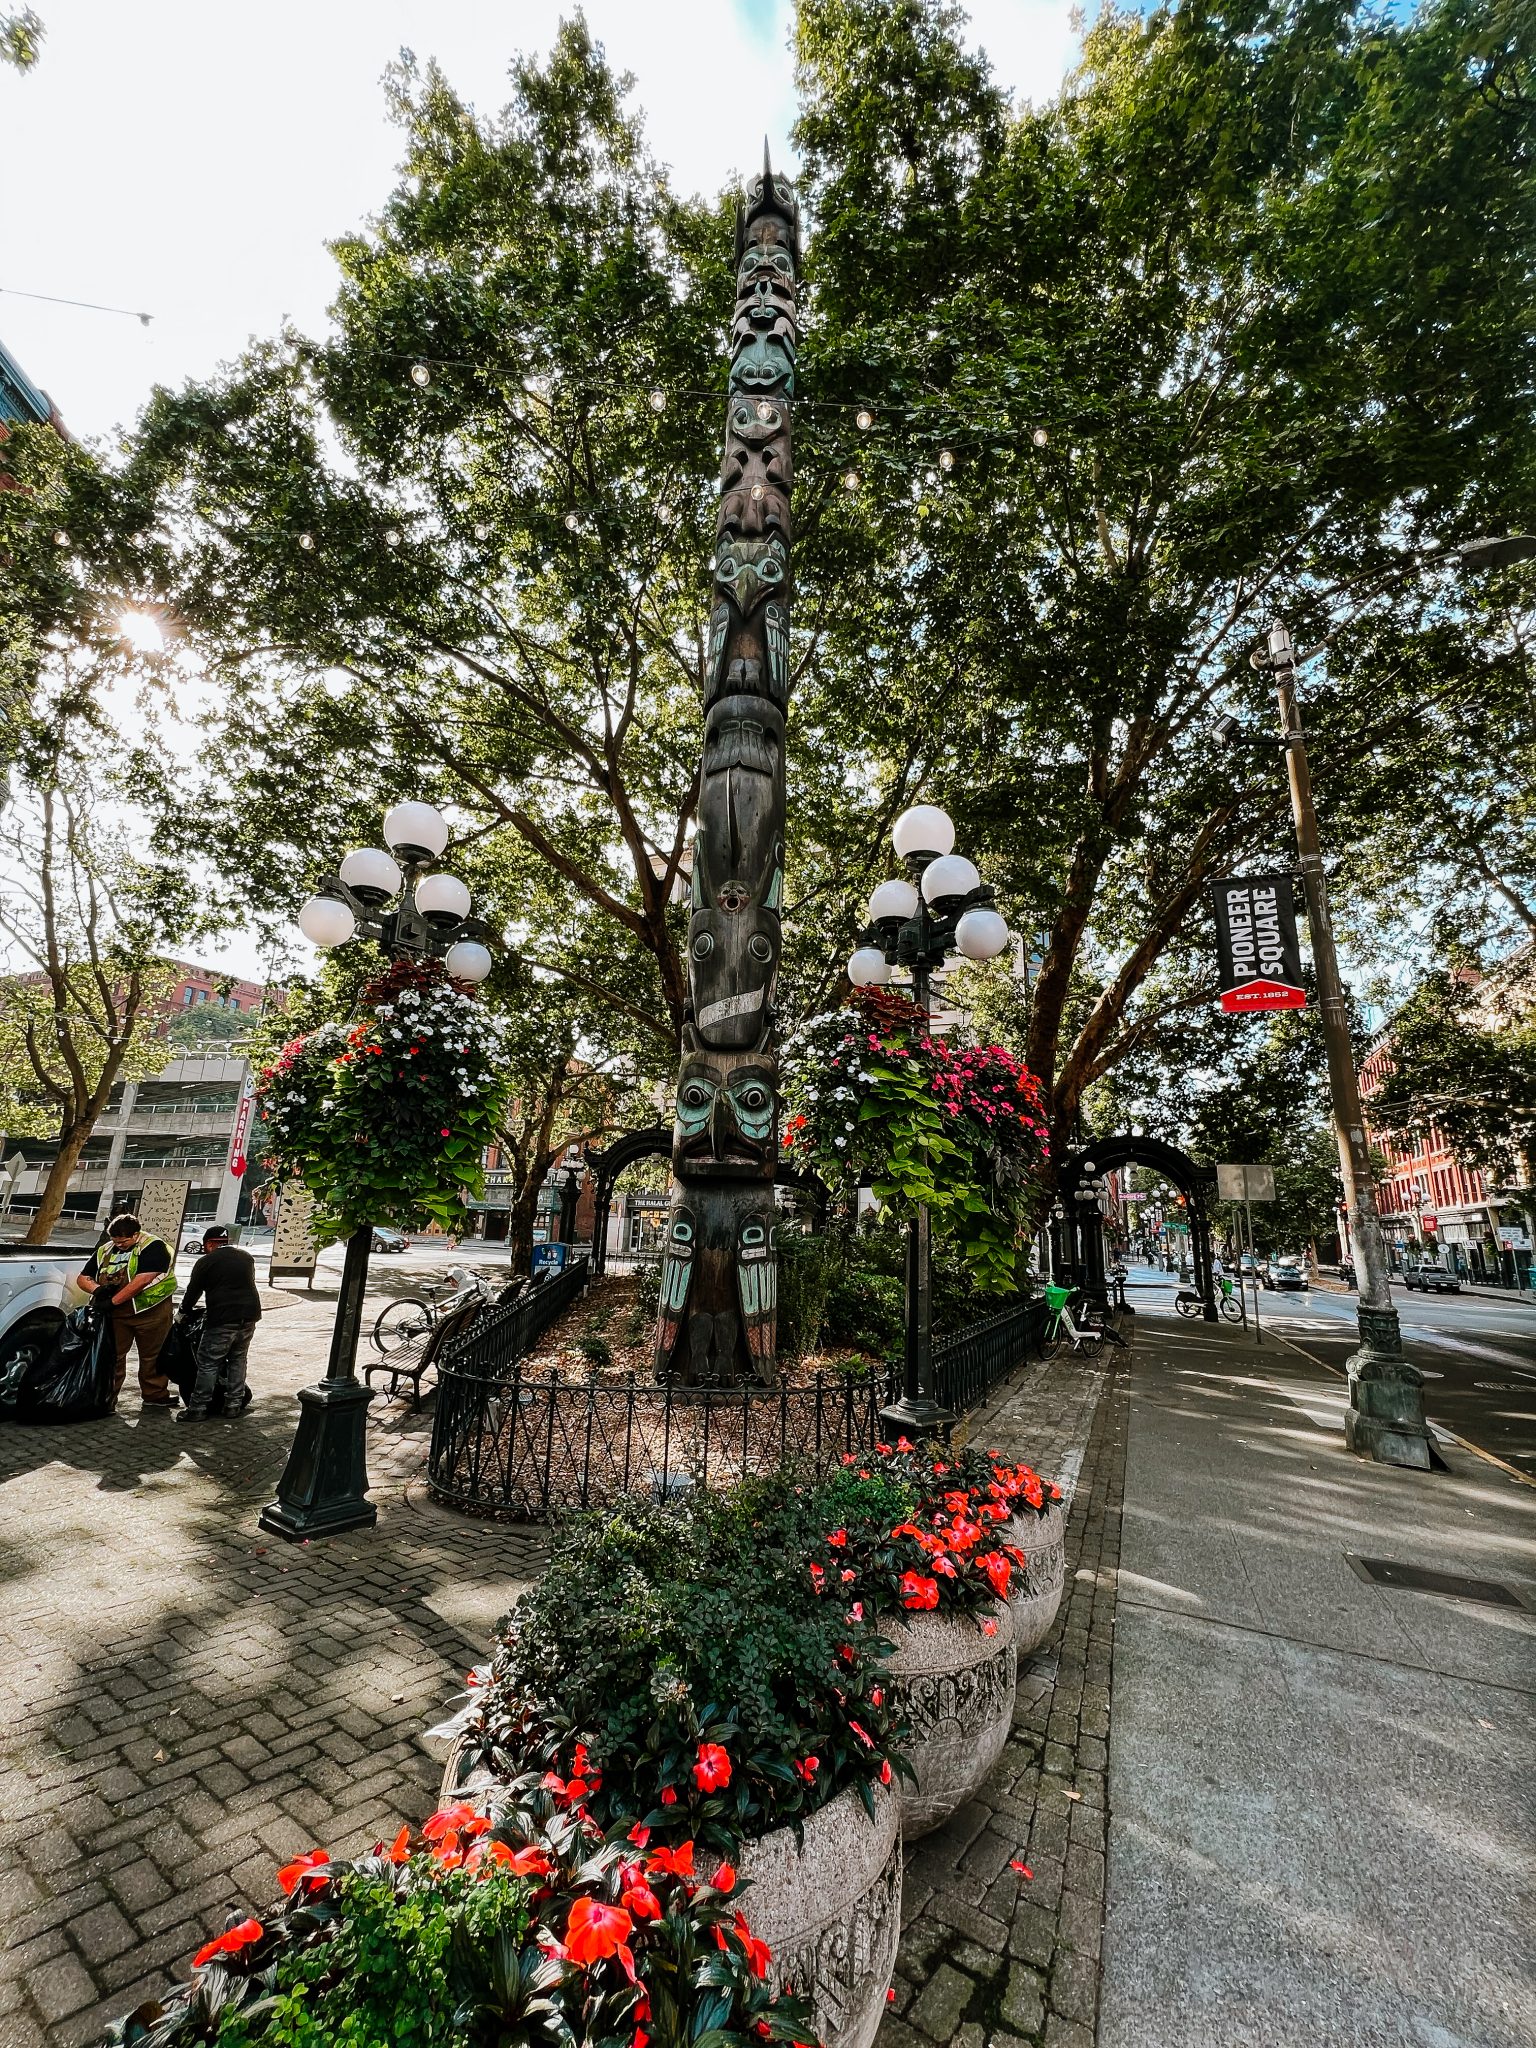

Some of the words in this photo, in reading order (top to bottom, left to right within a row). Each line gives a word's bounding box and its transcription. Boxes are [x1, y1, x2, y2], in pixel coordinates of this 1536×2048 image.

[1226, 888, 1257, 977] PIONEER
[1252, 886, 1285, 975] SQUARE
[232, 1101, 249, 1168] PARKING
